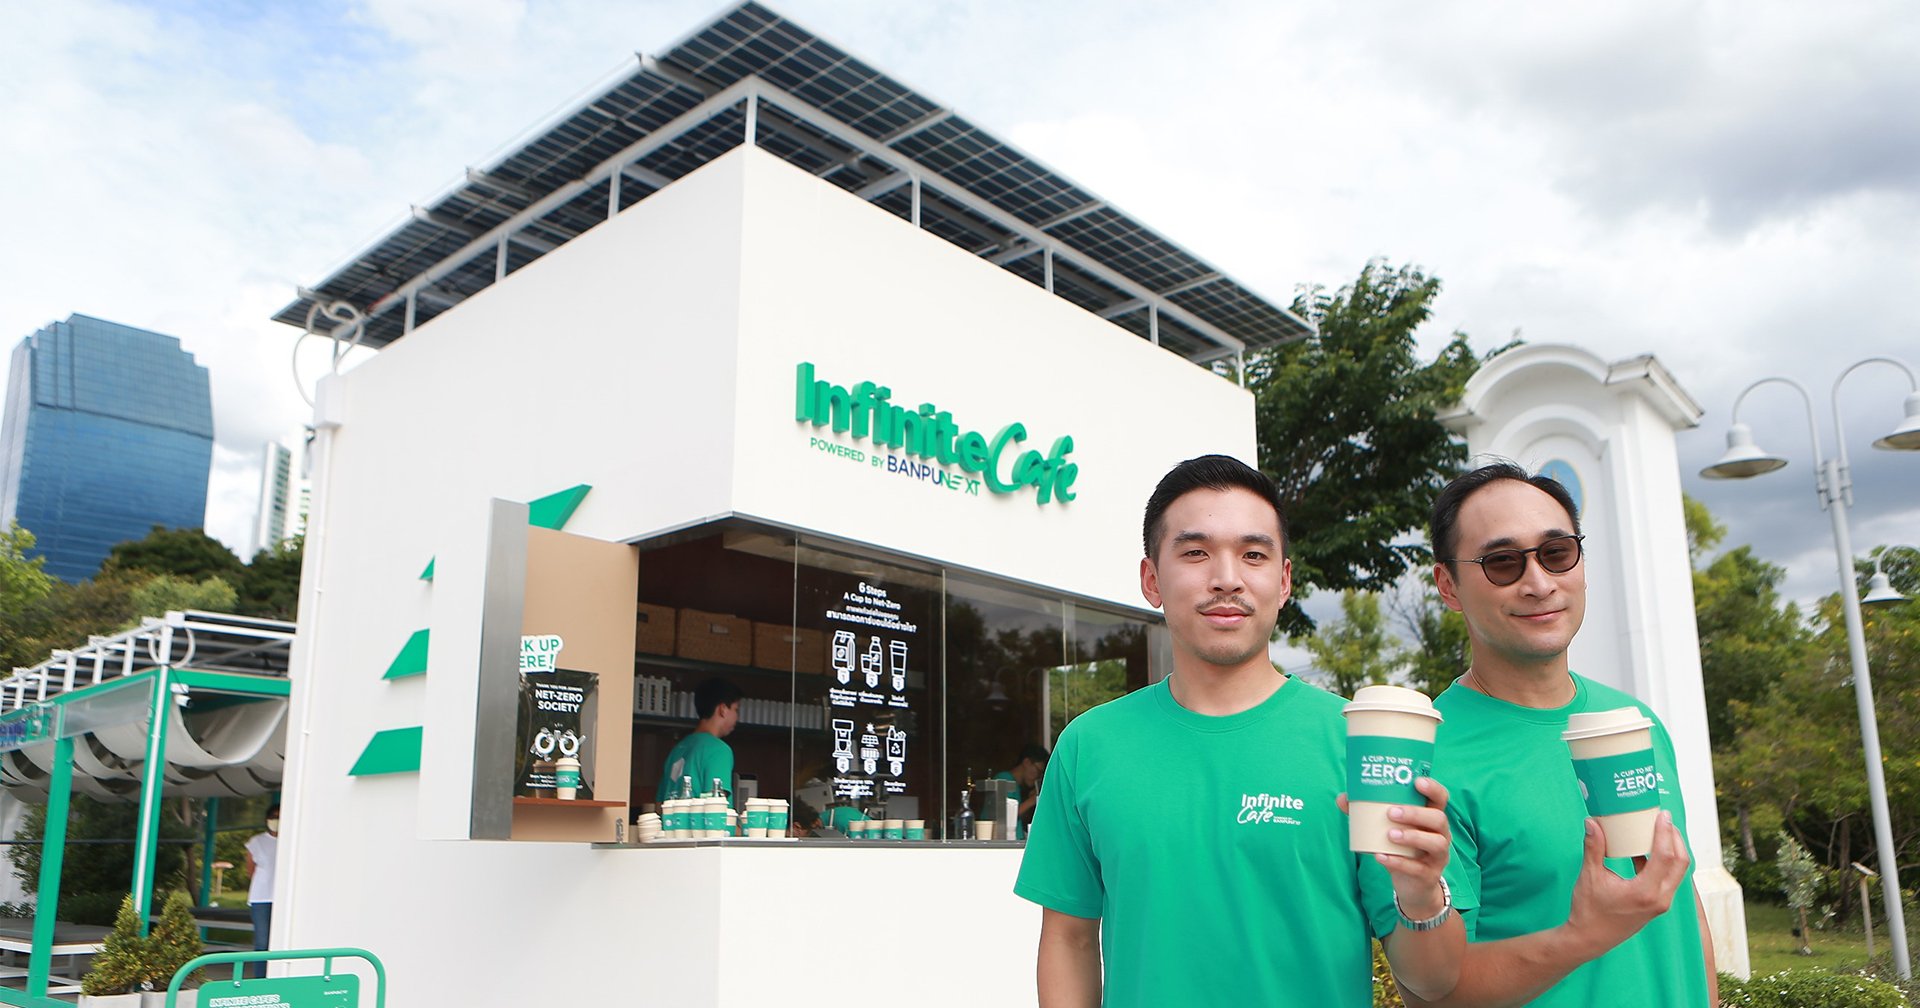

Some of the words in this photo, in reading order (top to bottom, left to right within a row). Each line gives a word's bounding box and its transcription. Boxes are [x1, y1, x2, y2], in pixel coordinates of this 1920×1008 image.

[810, 437, 865, 463] POWERED
[871, 456, 885, 468] BY
[843, 592, 850, 601] A
[850, 593, 864, 604] Cup
[865, 596, 872, 604] to
[858, 582, 866, 593] 6
[866, 585, 887, 598] Steps
[540, 639, 559, 651] UP
[520, 653, 554, 670] ERE!
[535, 689, 583, 703] NET-ZERO
[538, 700, 579, 713] SOCIETY
[1368, 755, 1384, 763] CUP
[1385, 756, 1396, 764] TO
[1398, 757, 1413, 765] NET
[1361, 763, 1412, 785] ZERO
[1614, 773, 1656, 791] ZERO
[1621, 770, 1635, 778] CUP
[1241, 793, 1304, 810] Infinite
[1237, 805, 1273, 825] Cafe
